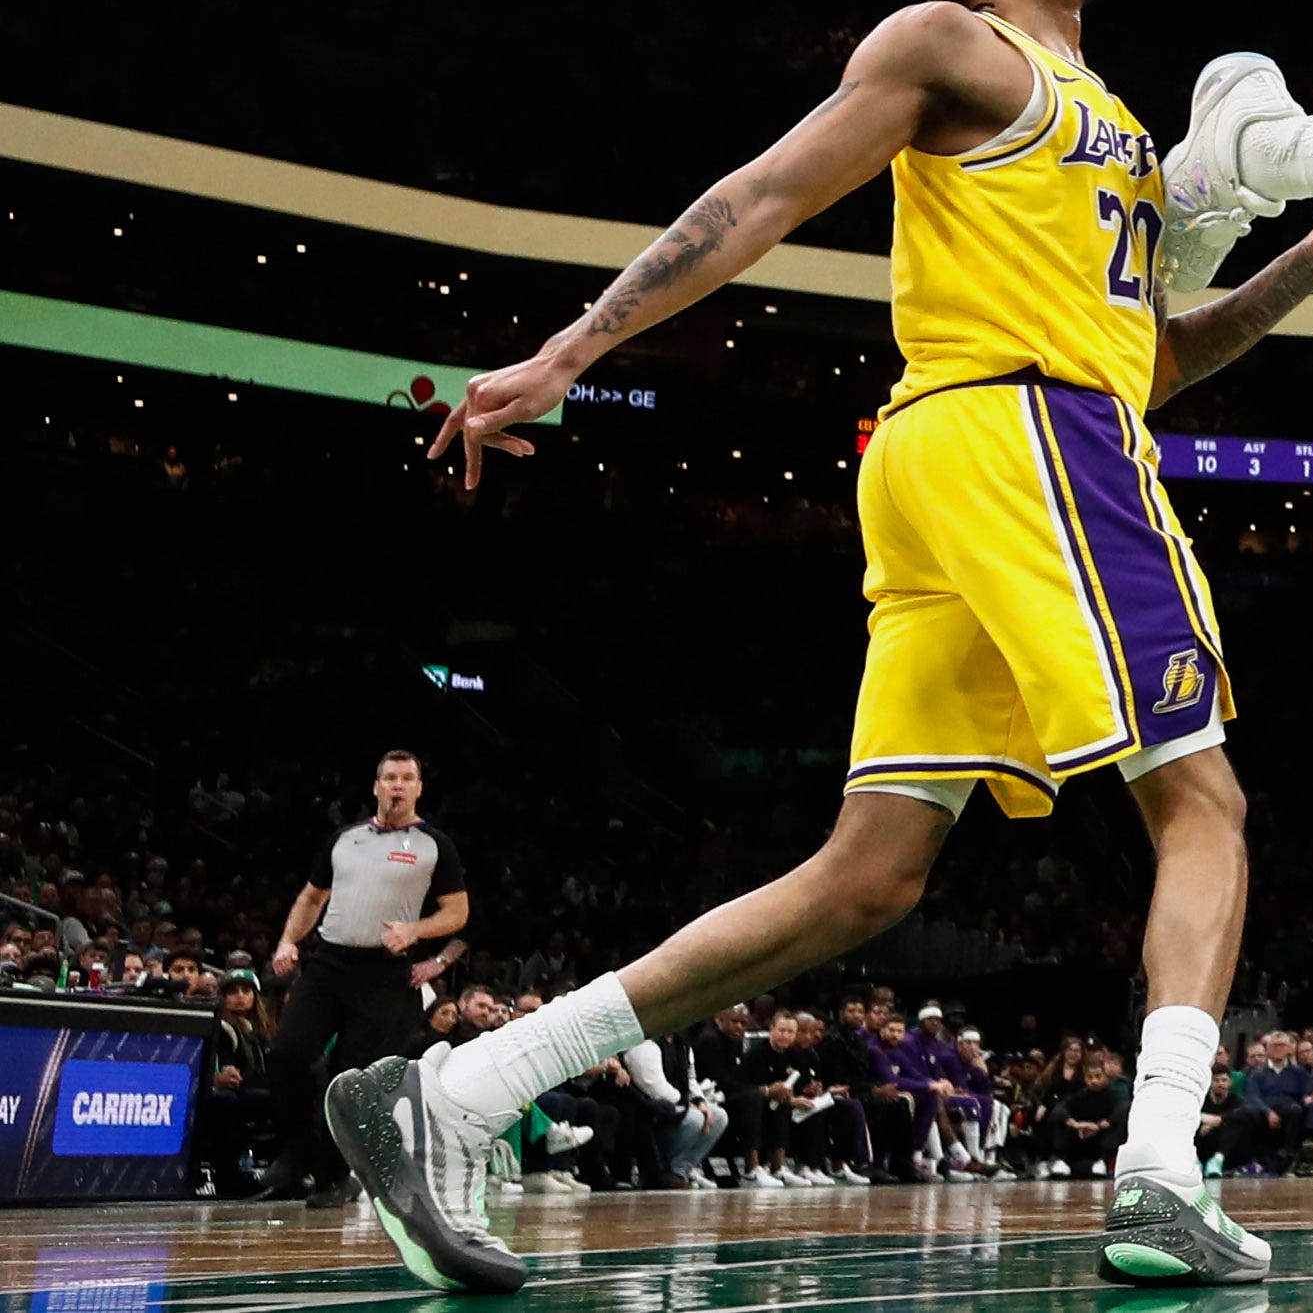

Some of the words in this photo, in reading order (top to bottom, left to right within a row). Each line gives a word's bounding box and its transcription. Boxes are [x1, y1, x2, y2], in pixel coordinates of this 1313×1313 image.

[629, 389, 656, 409] GE
[1195, 440, 1217, 451] REB
[1244, 443, 1266, 454] AST
[1296, 445, 1313, 456] STL
[1196, 456, 1217, 474] 10
[1249, 458, 1260, 476] 3
[1303, 461, 1310, 478] 1
[451, 672, 484, 691] Bank
[72, 1091, 174, 1126] CARmax
